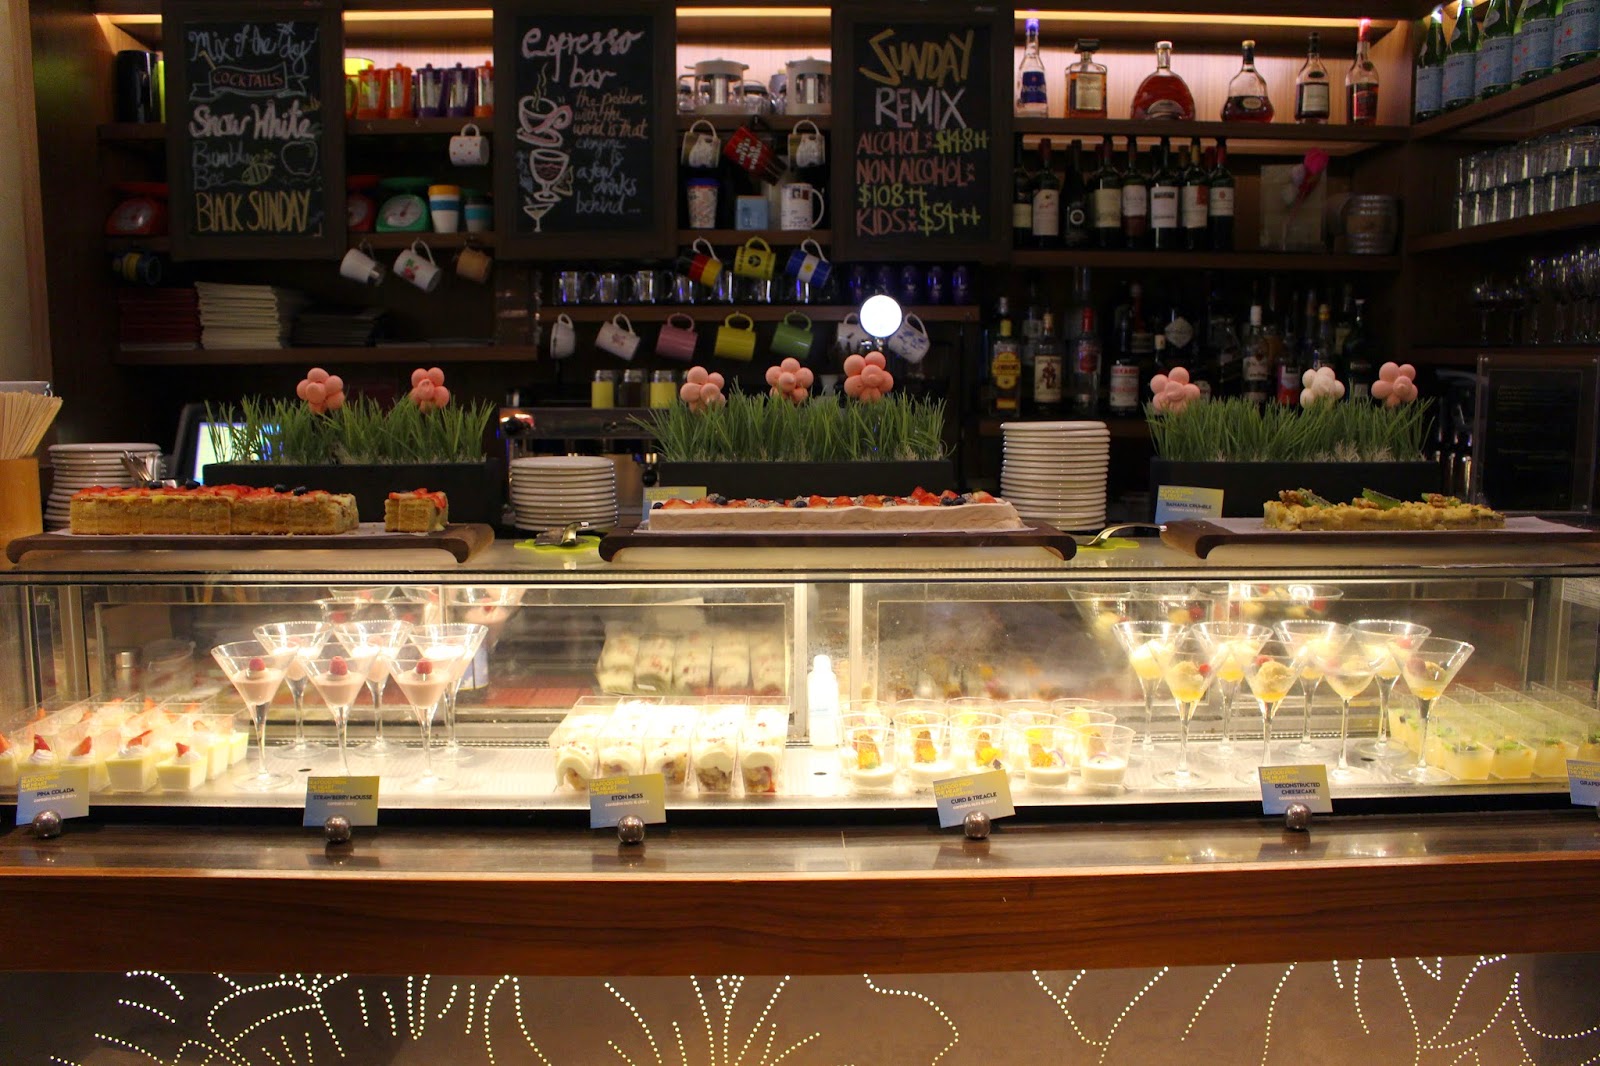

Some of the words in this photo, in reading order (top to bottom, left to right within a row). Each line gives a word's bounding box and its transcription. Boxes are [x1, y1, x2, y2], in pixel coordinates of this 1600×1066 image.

[188, 31, 235, 62] Mix
[859, 29, 974, 87] SUNDAY
[213, 72, 284, 88] COCKTAILS
[569, 55, 617, 89] bar
[189, 104, 251, 138] Snow
[250, 99, 316, 140] White
[875, 87, 967, 129] REMIX
[856, 158, 895, 185] NON
[247, 189, 311, 232] SUNDAY
[973, 792, 998, 800] TREACLE
